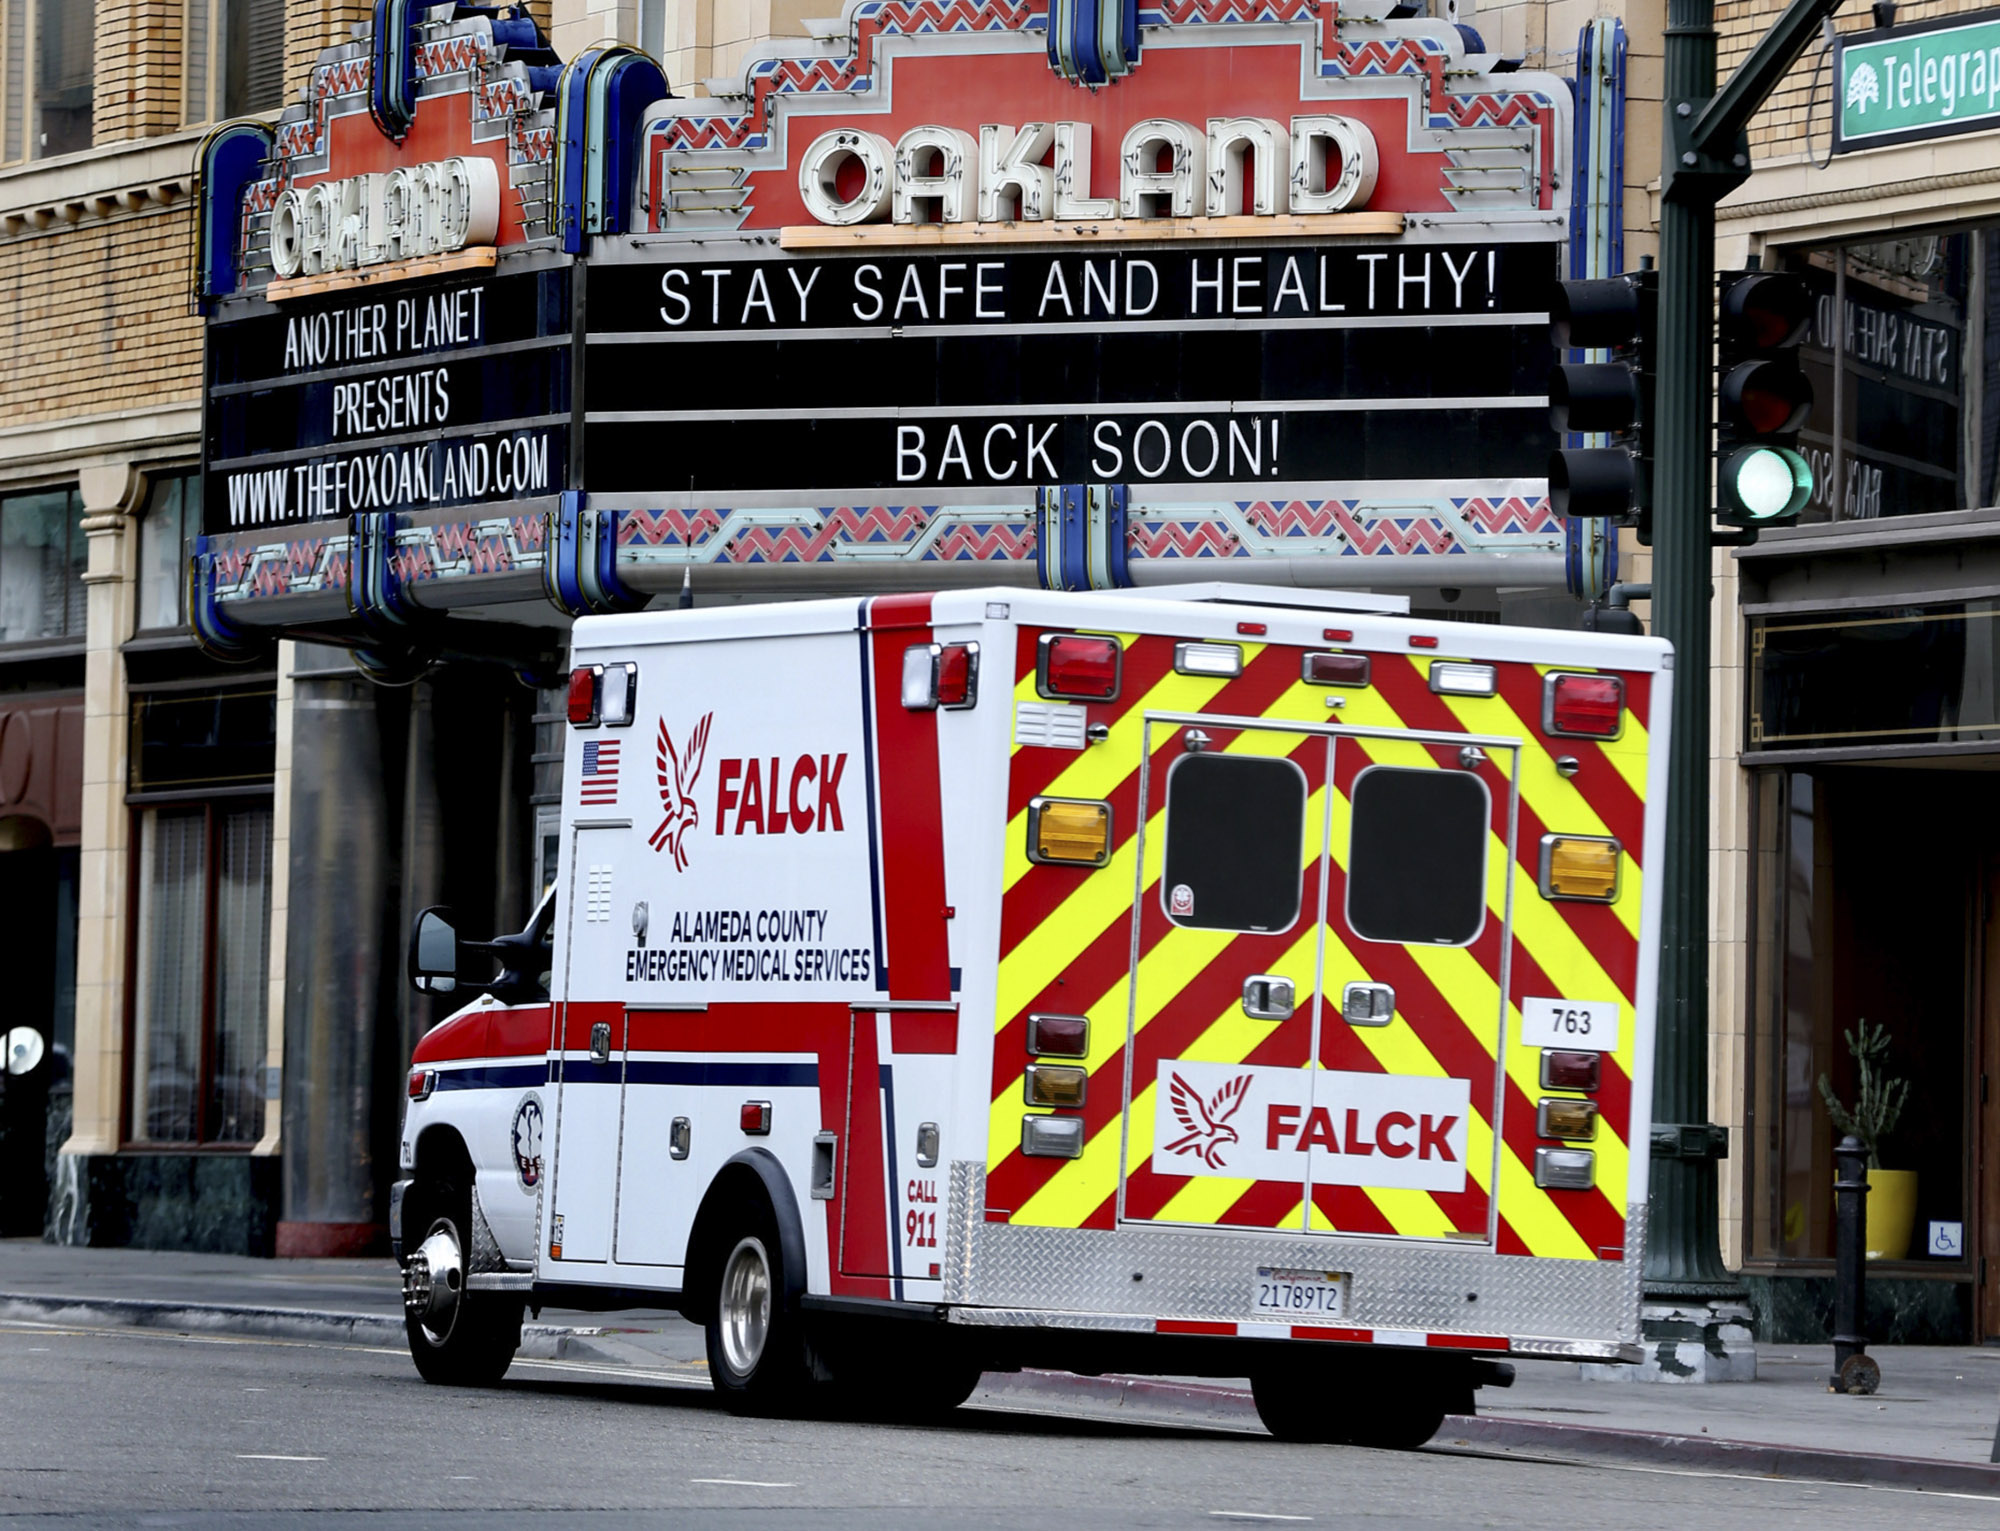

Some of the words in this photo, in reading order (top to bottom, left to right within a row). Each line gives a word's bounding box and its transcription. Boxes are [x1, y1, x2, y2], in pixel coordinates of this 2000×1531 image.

[799, 114, 1379, 226] OAKLAND
[270, 156, 499, 279] OAKLAND
[660, 266, 822, 325] STAY
[852, 264, 1006, 322] SAFE
[1038, 257, 1159, 317] AND
[1191, 250, 1496, 314] HEALTHY!
[284, 304, 387, 369] ANOTHER
[397, 286, 484, 351] PLANET
[332, 368, 449, 437] PRESENTS
[228, 434, 548, 526] WWW.THEFOXOAKLAND.COM
[896, 423, 1059, 481] BACK
[1091, 419, 1279, 478] SOON!
[715, 753, 848, 836] FALCK
[670, 911, 752, 943] ALAMEDA
[756, 909, 828, 943] COUNTY
[625, 949, 719, 982] EMERGENCY
[721, 949, 790, 982] MEDICAL
[793, 948, 871, 982] SERVICES
[1552, 1008, 1592, 1035] 763
[1265, 1103, 1460, 1163] FALCK
[907, 1179, 938, 1203] CALL
[906, 1209, 937, 1248] 911
[1259, 1284, 1337, 1311] 21789T2
